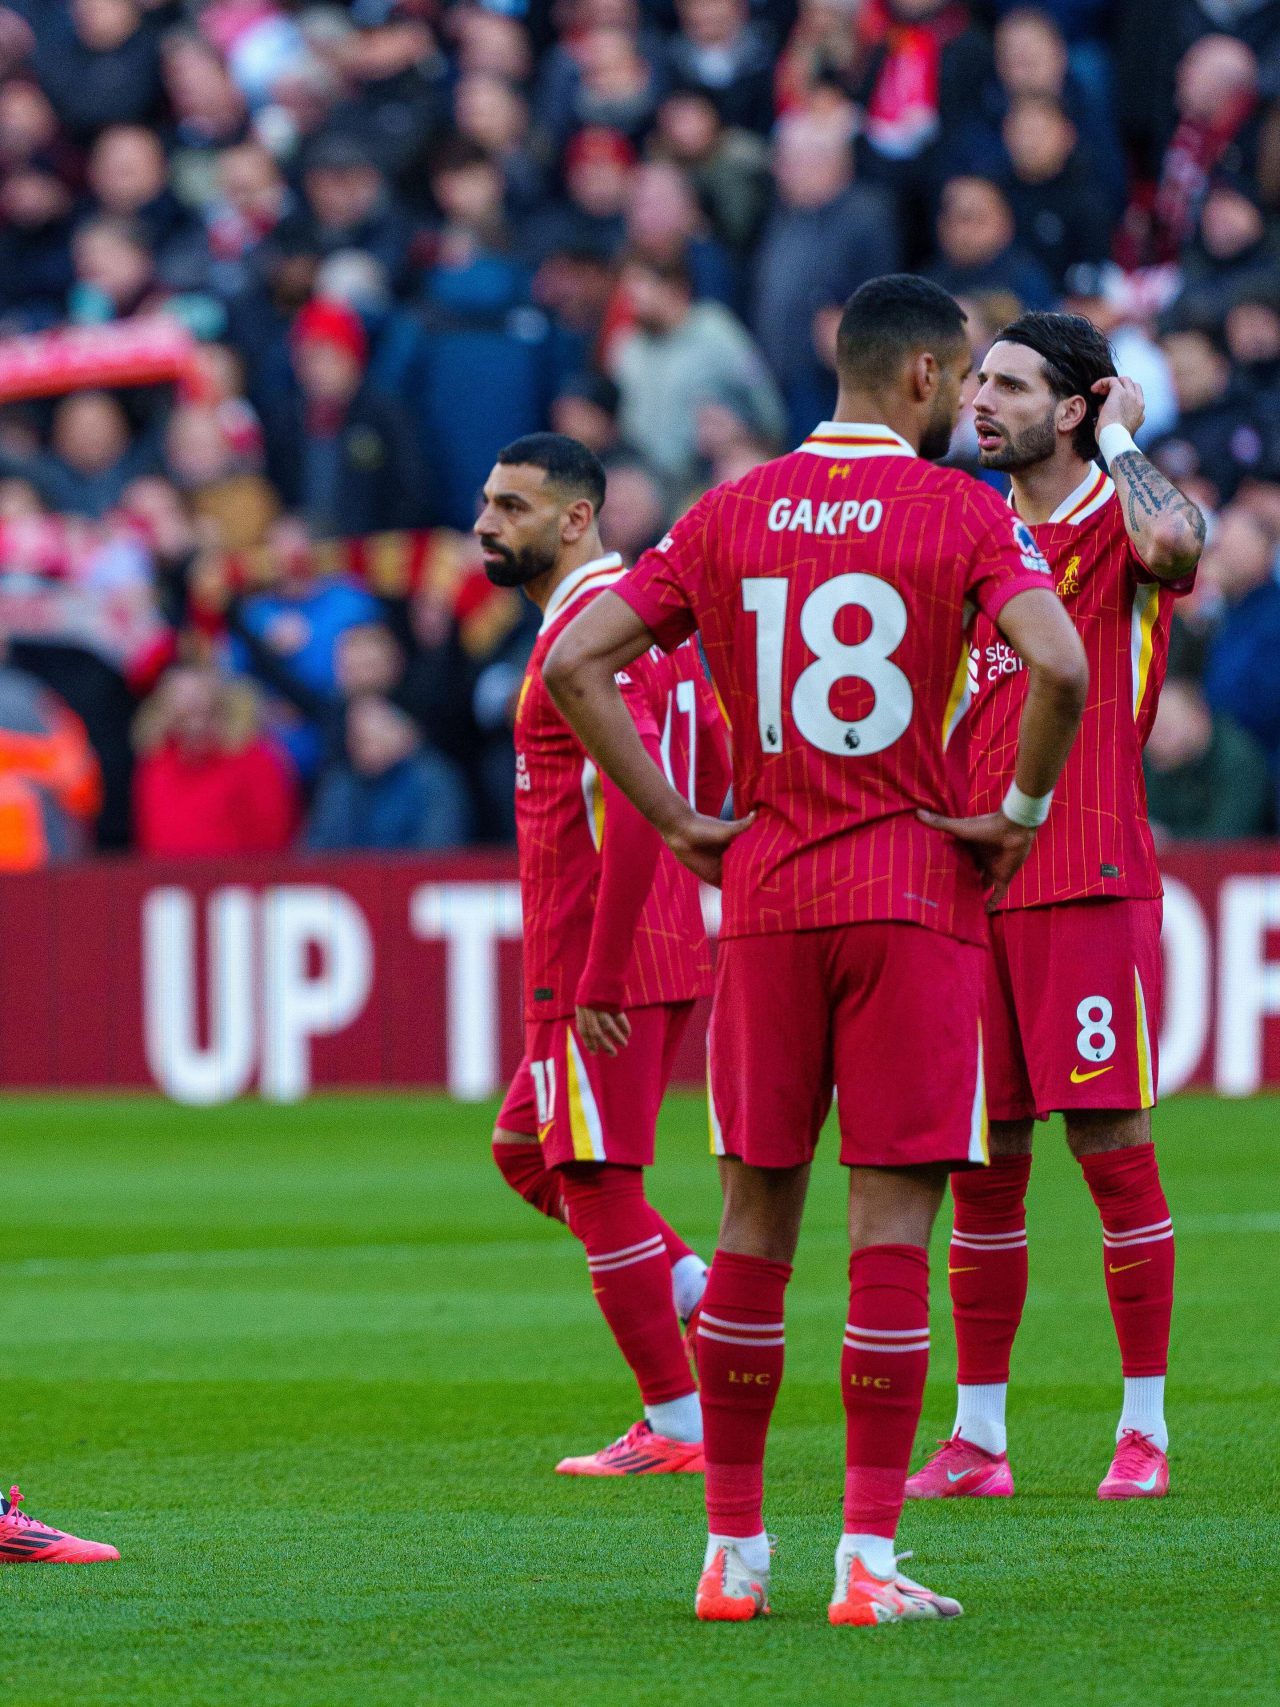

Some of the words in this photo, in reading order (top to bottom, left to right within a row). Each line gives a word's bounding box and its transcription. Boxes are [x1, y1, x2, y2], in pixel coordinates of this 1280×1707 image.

[768, 498, 883, 535] GAKPO
[741, 572, 914, 757] 18
[141, 884, 376, 1106] UP
[1076, 995, 1116, 1062] 8
[728, 1370, 770, 1385] LFC
[850, 1374, 891, 1389] LFC
